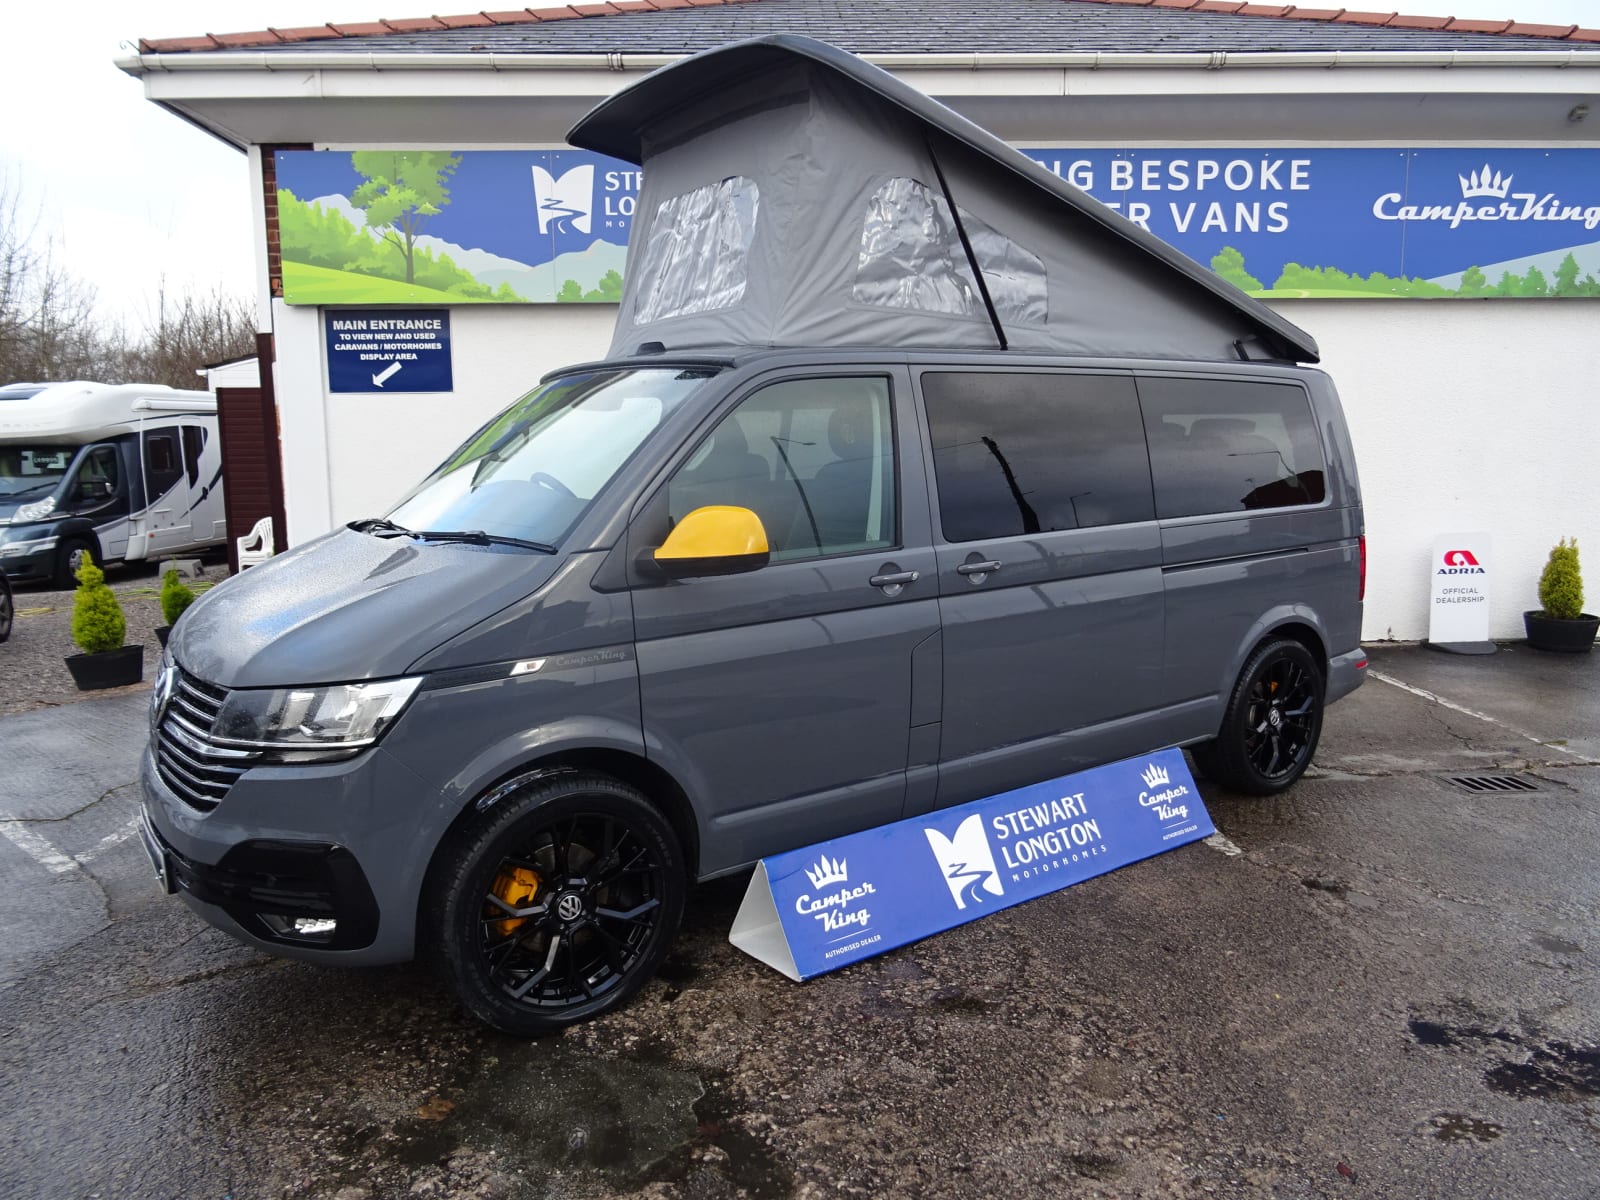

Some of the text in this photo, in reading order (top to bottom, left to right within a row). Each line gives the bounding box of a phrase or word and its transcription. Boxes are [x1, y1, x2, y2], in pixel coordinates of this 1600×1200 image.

[1110, 159, 1311, 191] BESPOKE
[605, 196, 636, 216] LO
[1104, 202, 1289, 233] R VANS
[1372, 192, 1600, 230] CamperKing
[333, 320, 442, 330] MAIN ENTRANCE
[1436, 567, 1486, 575] ADRIA
[1435, 596, 1485, 604] DEALERSHIP
[1442, 587, 1479, 595] OFFICIAL
[1138, 785, 1189, 807] Camper
[992, 792, 1087, 839] STEWART
[1152, 803, 1189, 821] King
[1001, 818, 1102, 869] LONGTON
[1012, 844, 1107, 883] MOTORHOMES
[795, 881, 877, 915] Camper
[814, 908, 871, 932] King
[825, 934, 882, 959] AUTHORISED DEALER
